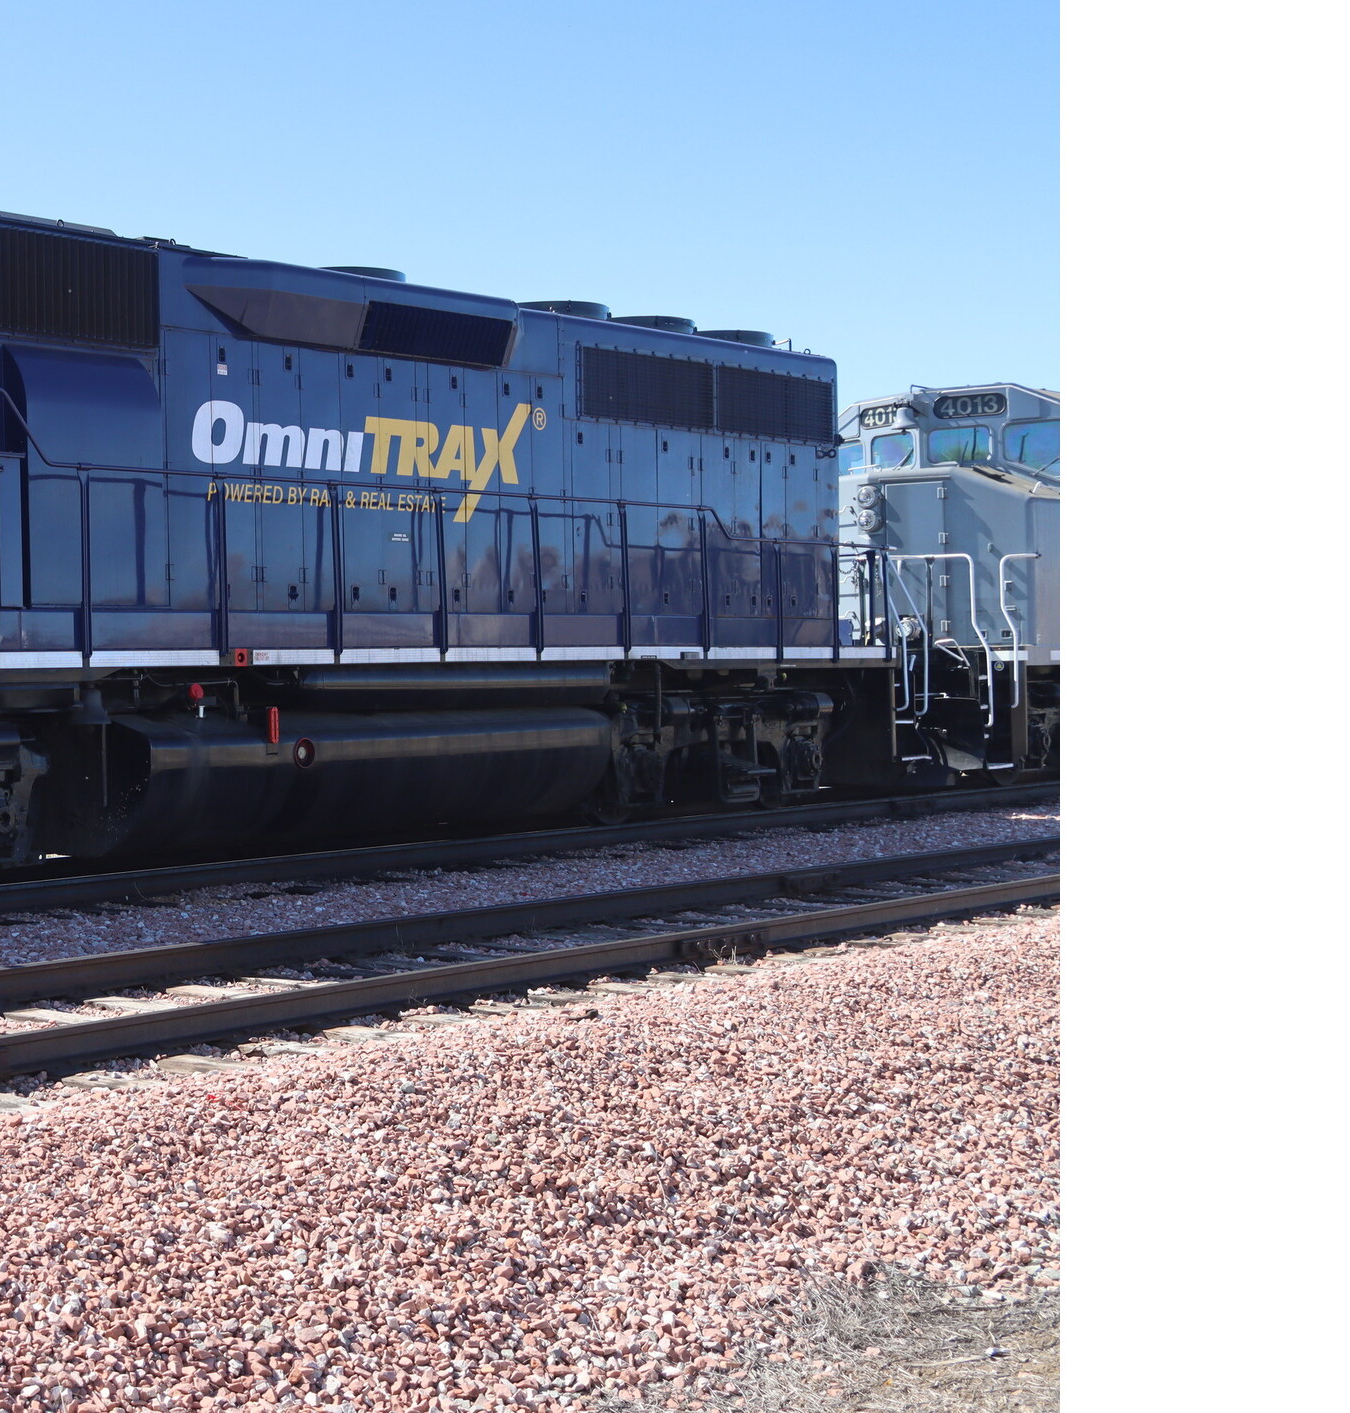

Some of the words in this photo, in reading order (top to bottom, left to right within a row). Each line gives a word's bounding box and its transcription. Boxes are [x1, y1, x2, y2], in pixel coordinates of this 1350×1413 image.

[940, 395, 999, 415] 4013
[287, 486, 308, 506] BY
[345, 490, 356, 509] &
[360, 491, 394, 511] REAL
